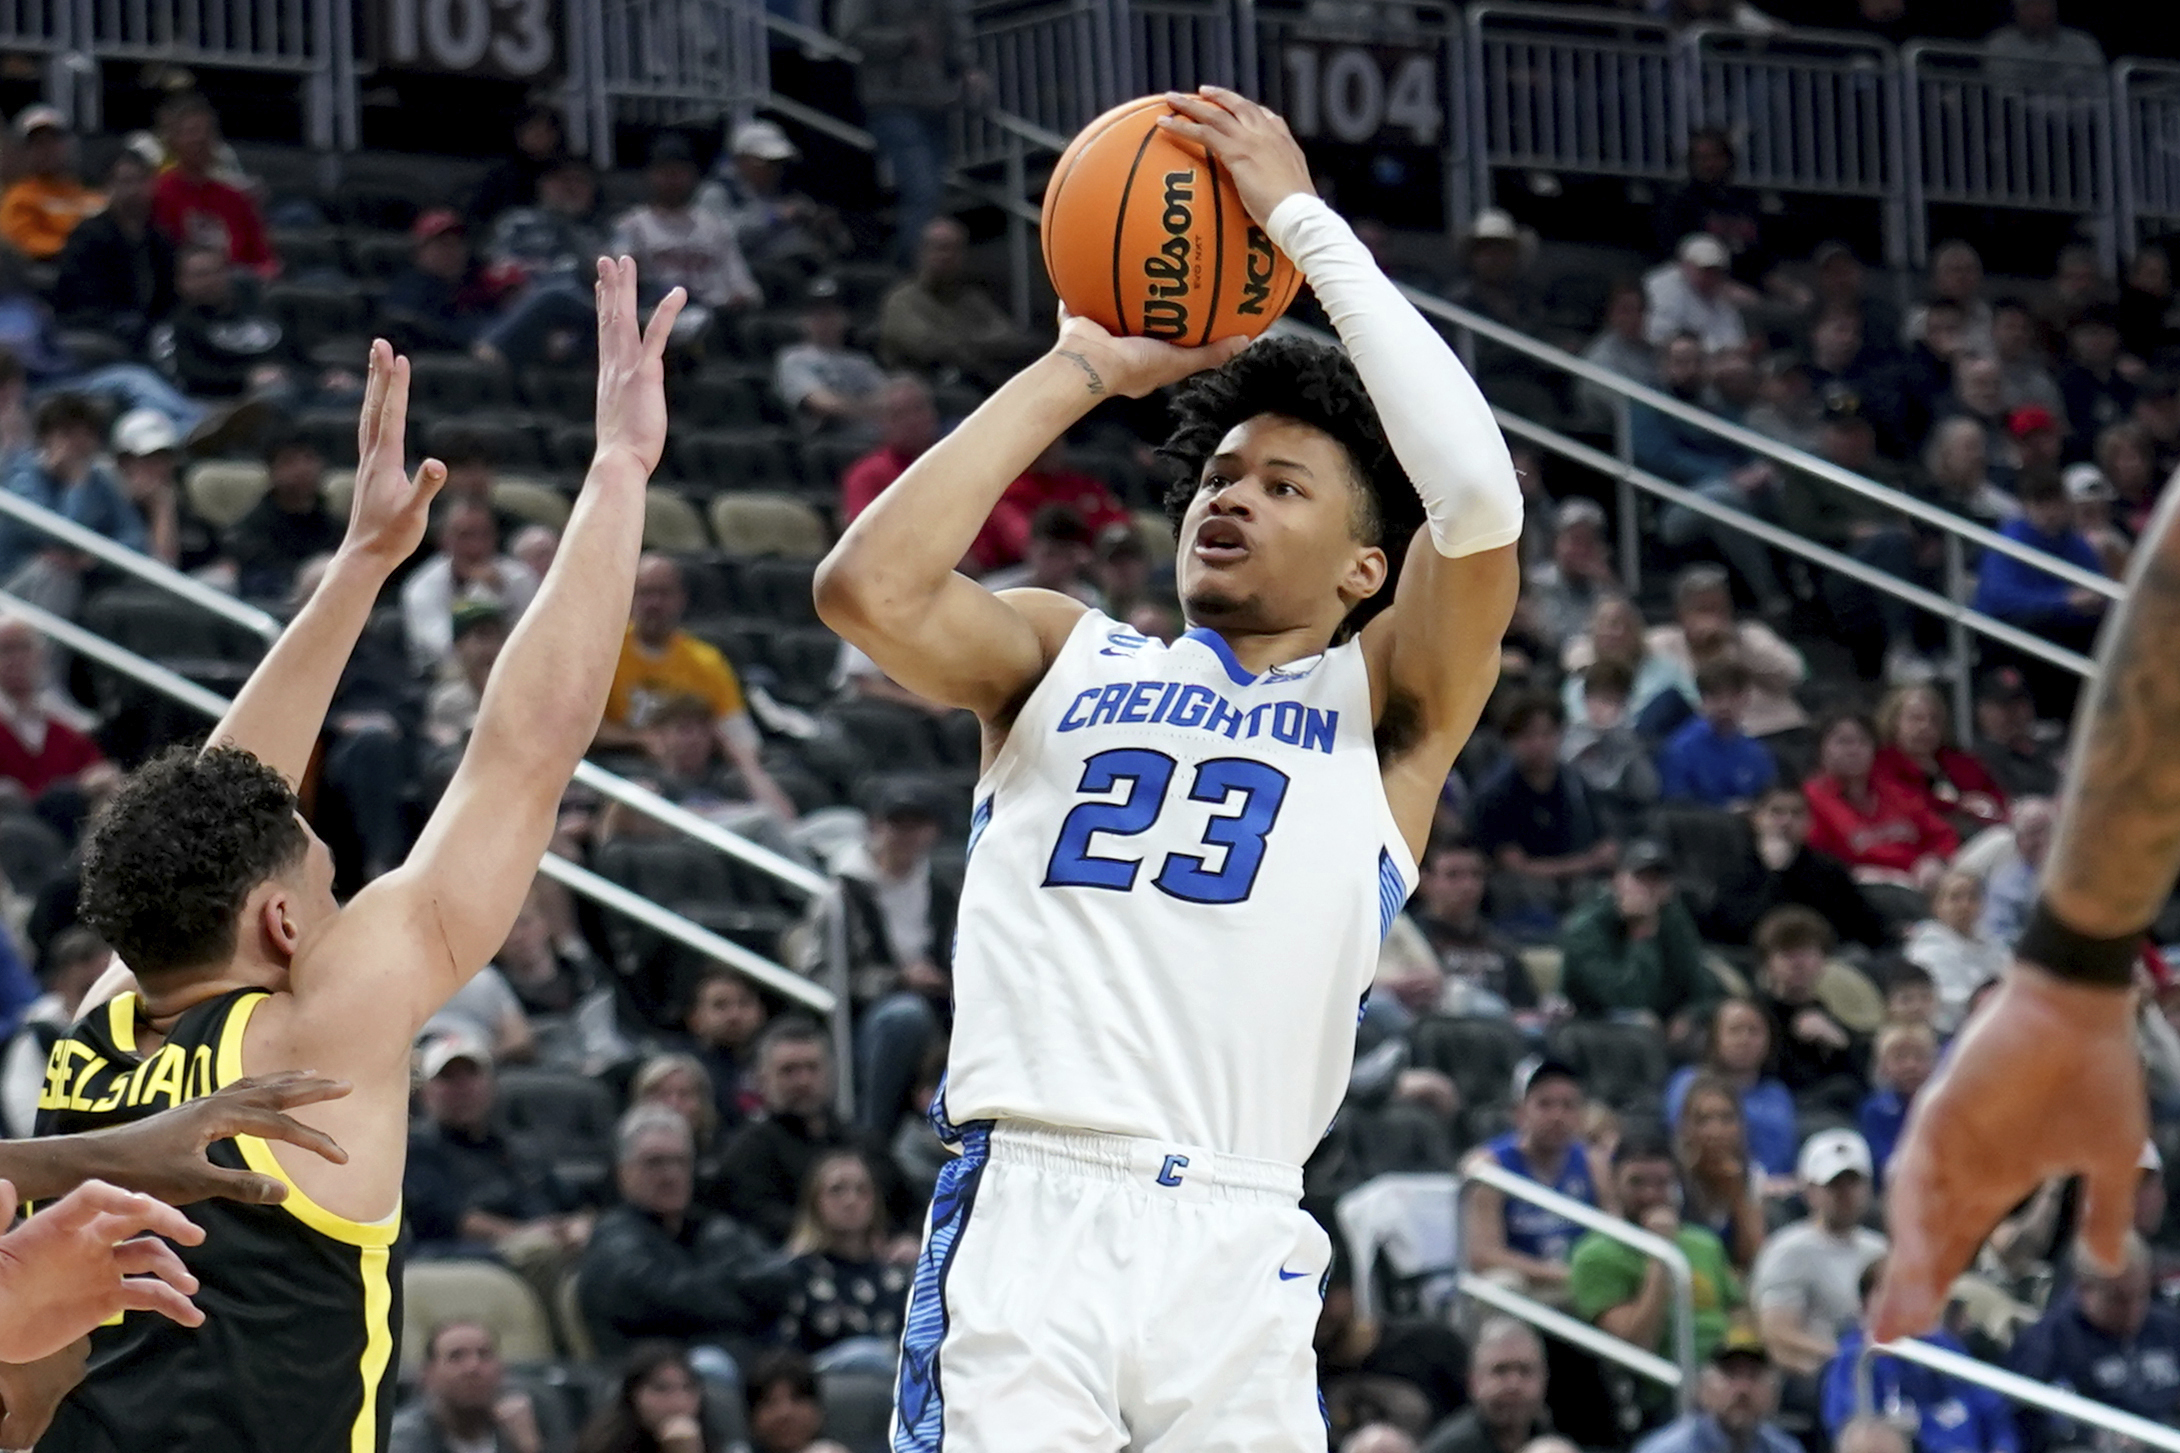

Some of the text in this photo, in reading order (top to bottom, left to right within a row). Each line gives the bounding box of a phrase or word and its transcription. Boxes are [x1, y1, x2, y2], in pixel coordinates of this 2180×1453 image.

[390, 0, 553, 75] 103
[1285, 47, 1442, 144] 104
[1143, 169, 1197, 341] Wilson
[1236, 208, 1276, 315] NCA
[1056, 680, 1339, 755] CREIGHTON
[1040, 746, 1291, 905] 23
[1155, 1154, 1190, 1187] C
